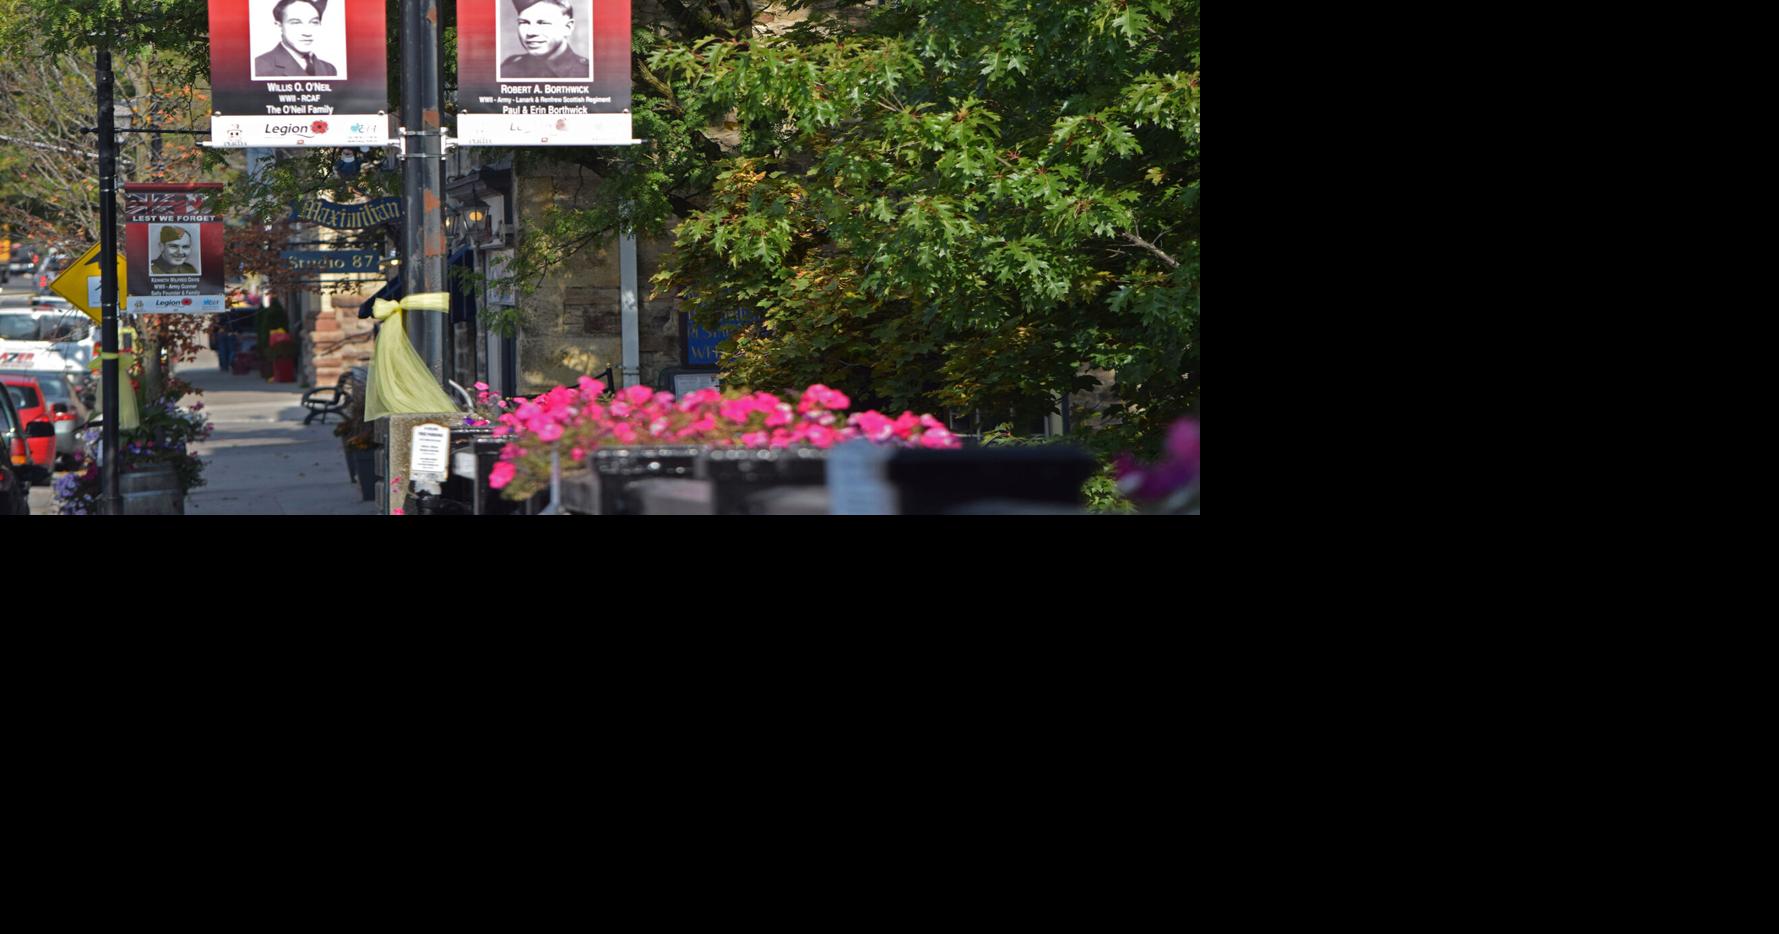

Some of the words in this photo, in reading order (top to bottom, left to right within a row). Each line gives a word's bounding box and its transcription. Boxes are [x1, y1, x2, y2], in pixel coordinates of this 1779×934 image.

[267, 82, 293, 92] WILLIS
[294, 82, 304, 92] O.
[305, 82, 332, 92] O'NEIL
[501, 84, 532, 94] ROBERT
[533, 84, 543, 94] A.
[544, 84, 589, 94] BORTHWICK
[301, 94, 320, 102] RCAF
[497, 96, 512, 104] Army
[586, 96, 611, 104] Regiment
[266, 105, 281, 114] The
[282, 105, 306, 114] O'Neil
[307, 104, 333, 115] Family
[503, 105, 520, 114] Paul
[522, 105, 528, 114] &
[530, 105, 546, 114] Erin
[548, 105, 588, 114] Borthwick
[265, 123, 308, 136] Legion
[298, 199, 399, 227] Maximilian
[352, 255, 373, 268] 87
[155, 299, 180, 308] Legion
